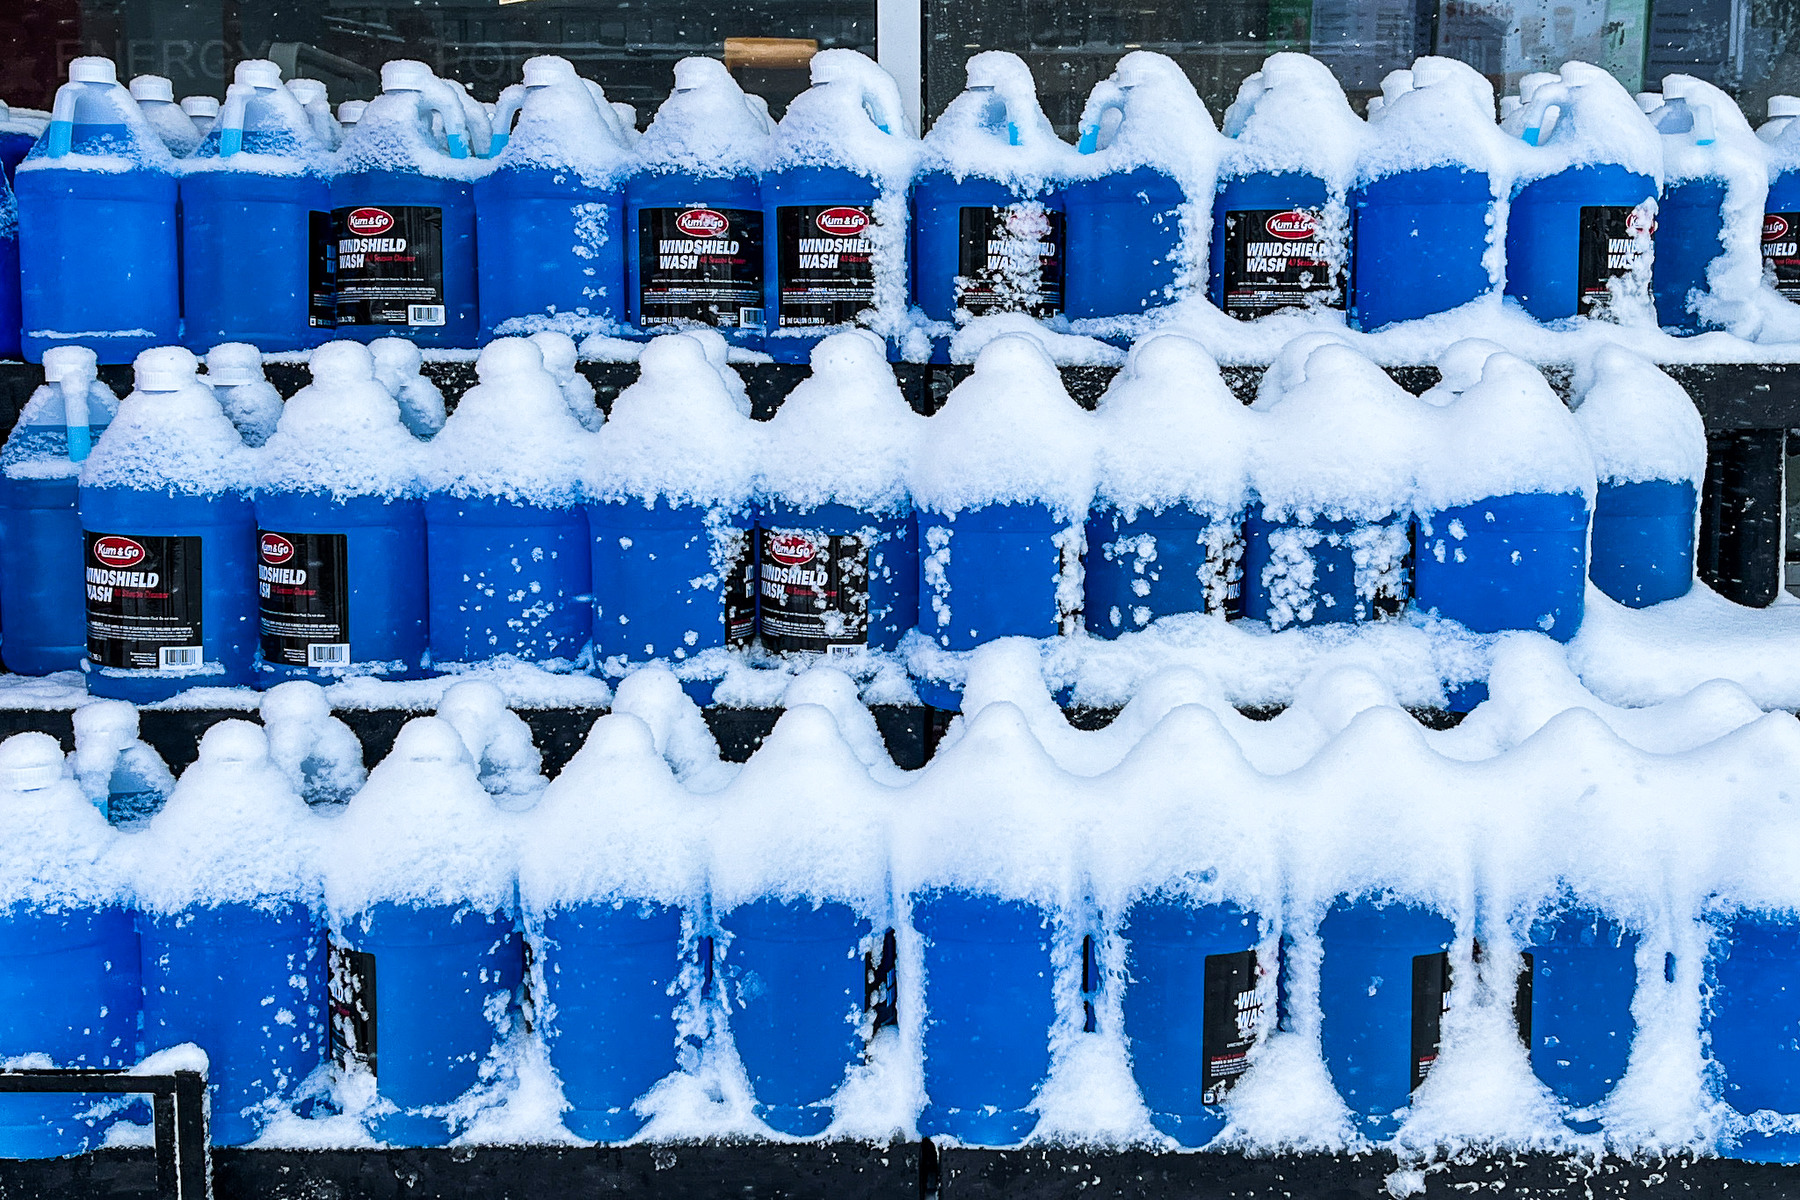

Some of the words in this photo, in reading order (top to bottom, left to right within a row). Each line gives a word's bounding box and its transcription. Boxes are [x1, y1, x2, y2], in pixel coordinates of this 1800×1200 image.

[339, 238, 407, 254] WINDSHIELD
[659, 239, 740, 255] WINDSHIELD
[1763, 242, 1798, 257] SHIELD
[339, 254, 365, 269] WASH
[659, 255, 699, 270] WASH
[799, 254, 839, 269] WASH
[1246, 257, 1287, 272] WASH
